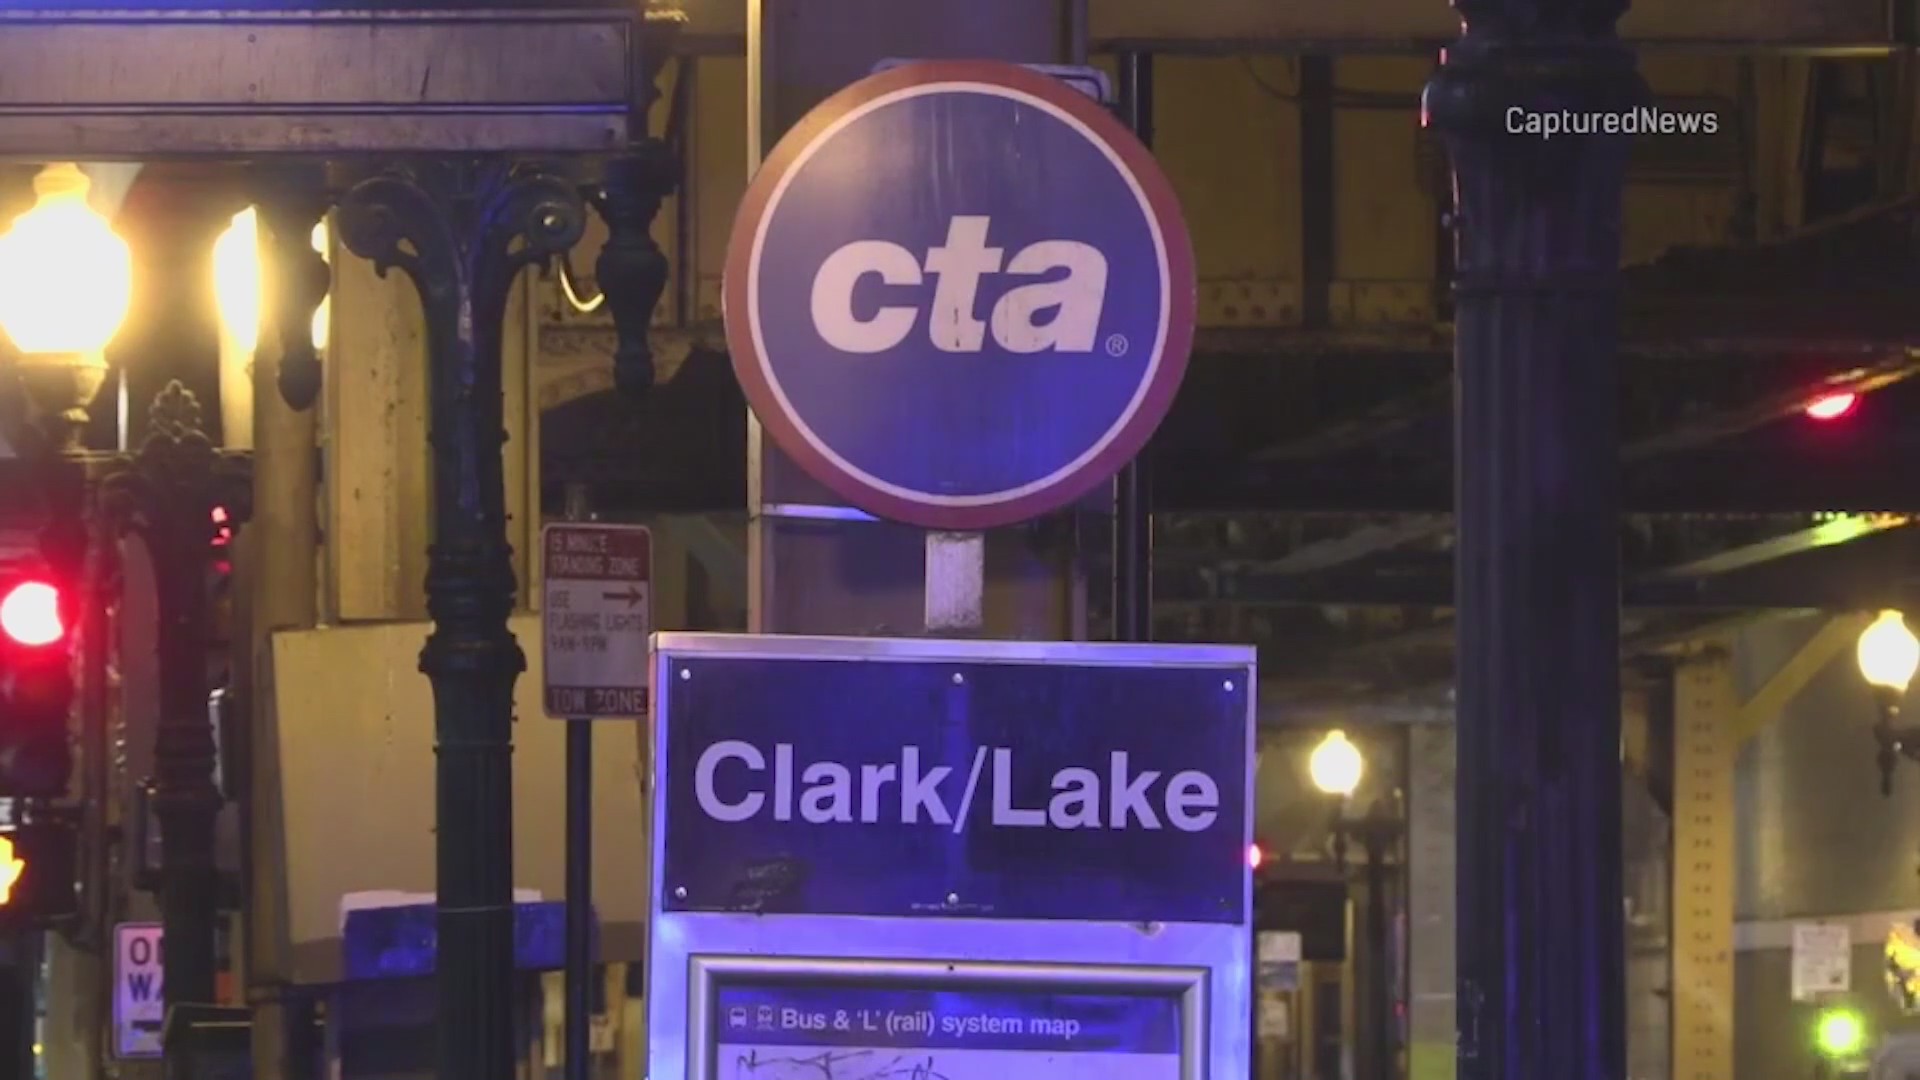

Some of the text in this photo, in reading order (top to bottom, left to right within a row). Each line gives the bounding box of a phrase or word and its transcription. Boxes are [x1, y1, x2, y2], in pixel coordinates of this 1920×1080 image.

[811, 215, 1108, 353] cta
[608, 556, 641, 577] ZONE
[551, 687, 645, 713] TOW ZONE
[695, 740, 1220, 834] Clark/Lake
[781, 1008, 826, 1031] Bus
[833, 1009, 851, 1031] &
[885, 1012, 936, 1037] (rail)
[941, 1012, 1024, 1037] system
[1030, 1016, 1081, 1040] map
